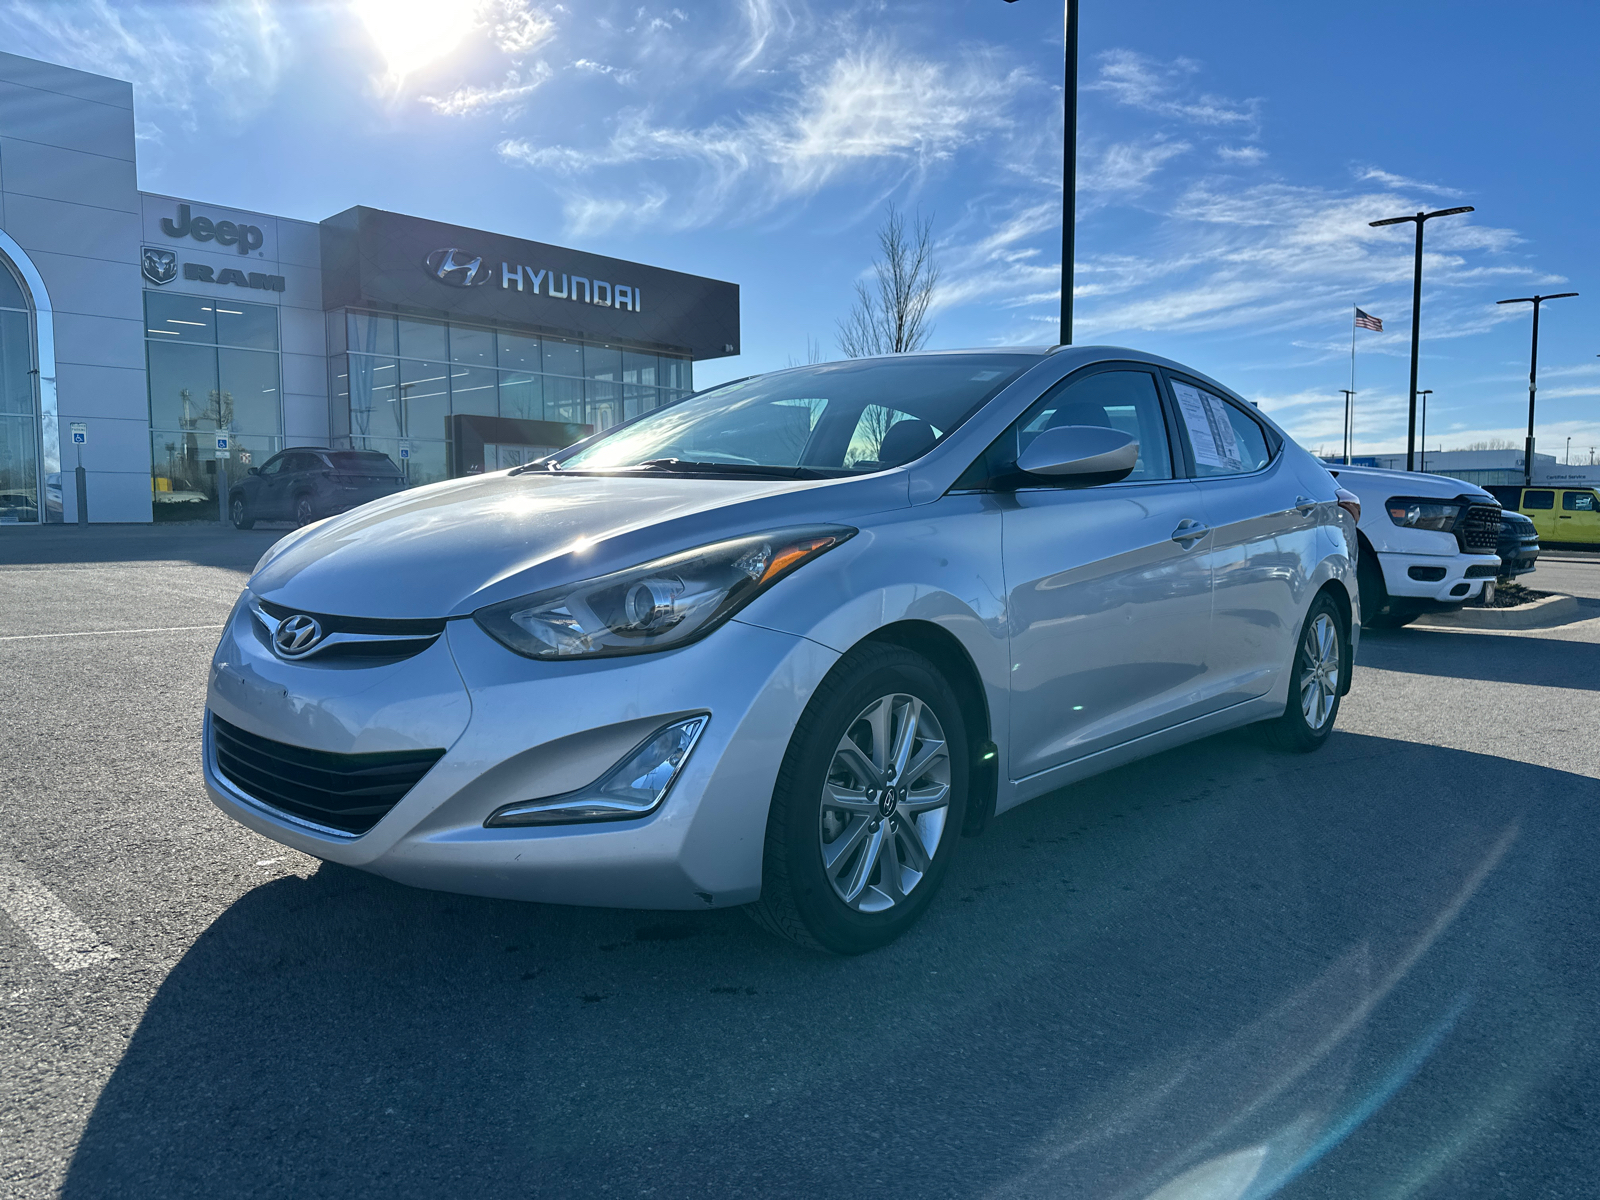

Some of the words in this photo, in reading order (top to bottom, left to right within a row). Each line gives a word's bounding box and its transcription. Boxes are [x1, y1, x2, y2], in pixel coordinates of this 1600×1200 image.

[160, 203, 263, 255] Jeep
[183, 262, 286, 293] RAM
[502, 261, 641, 313] HYUNDAI
